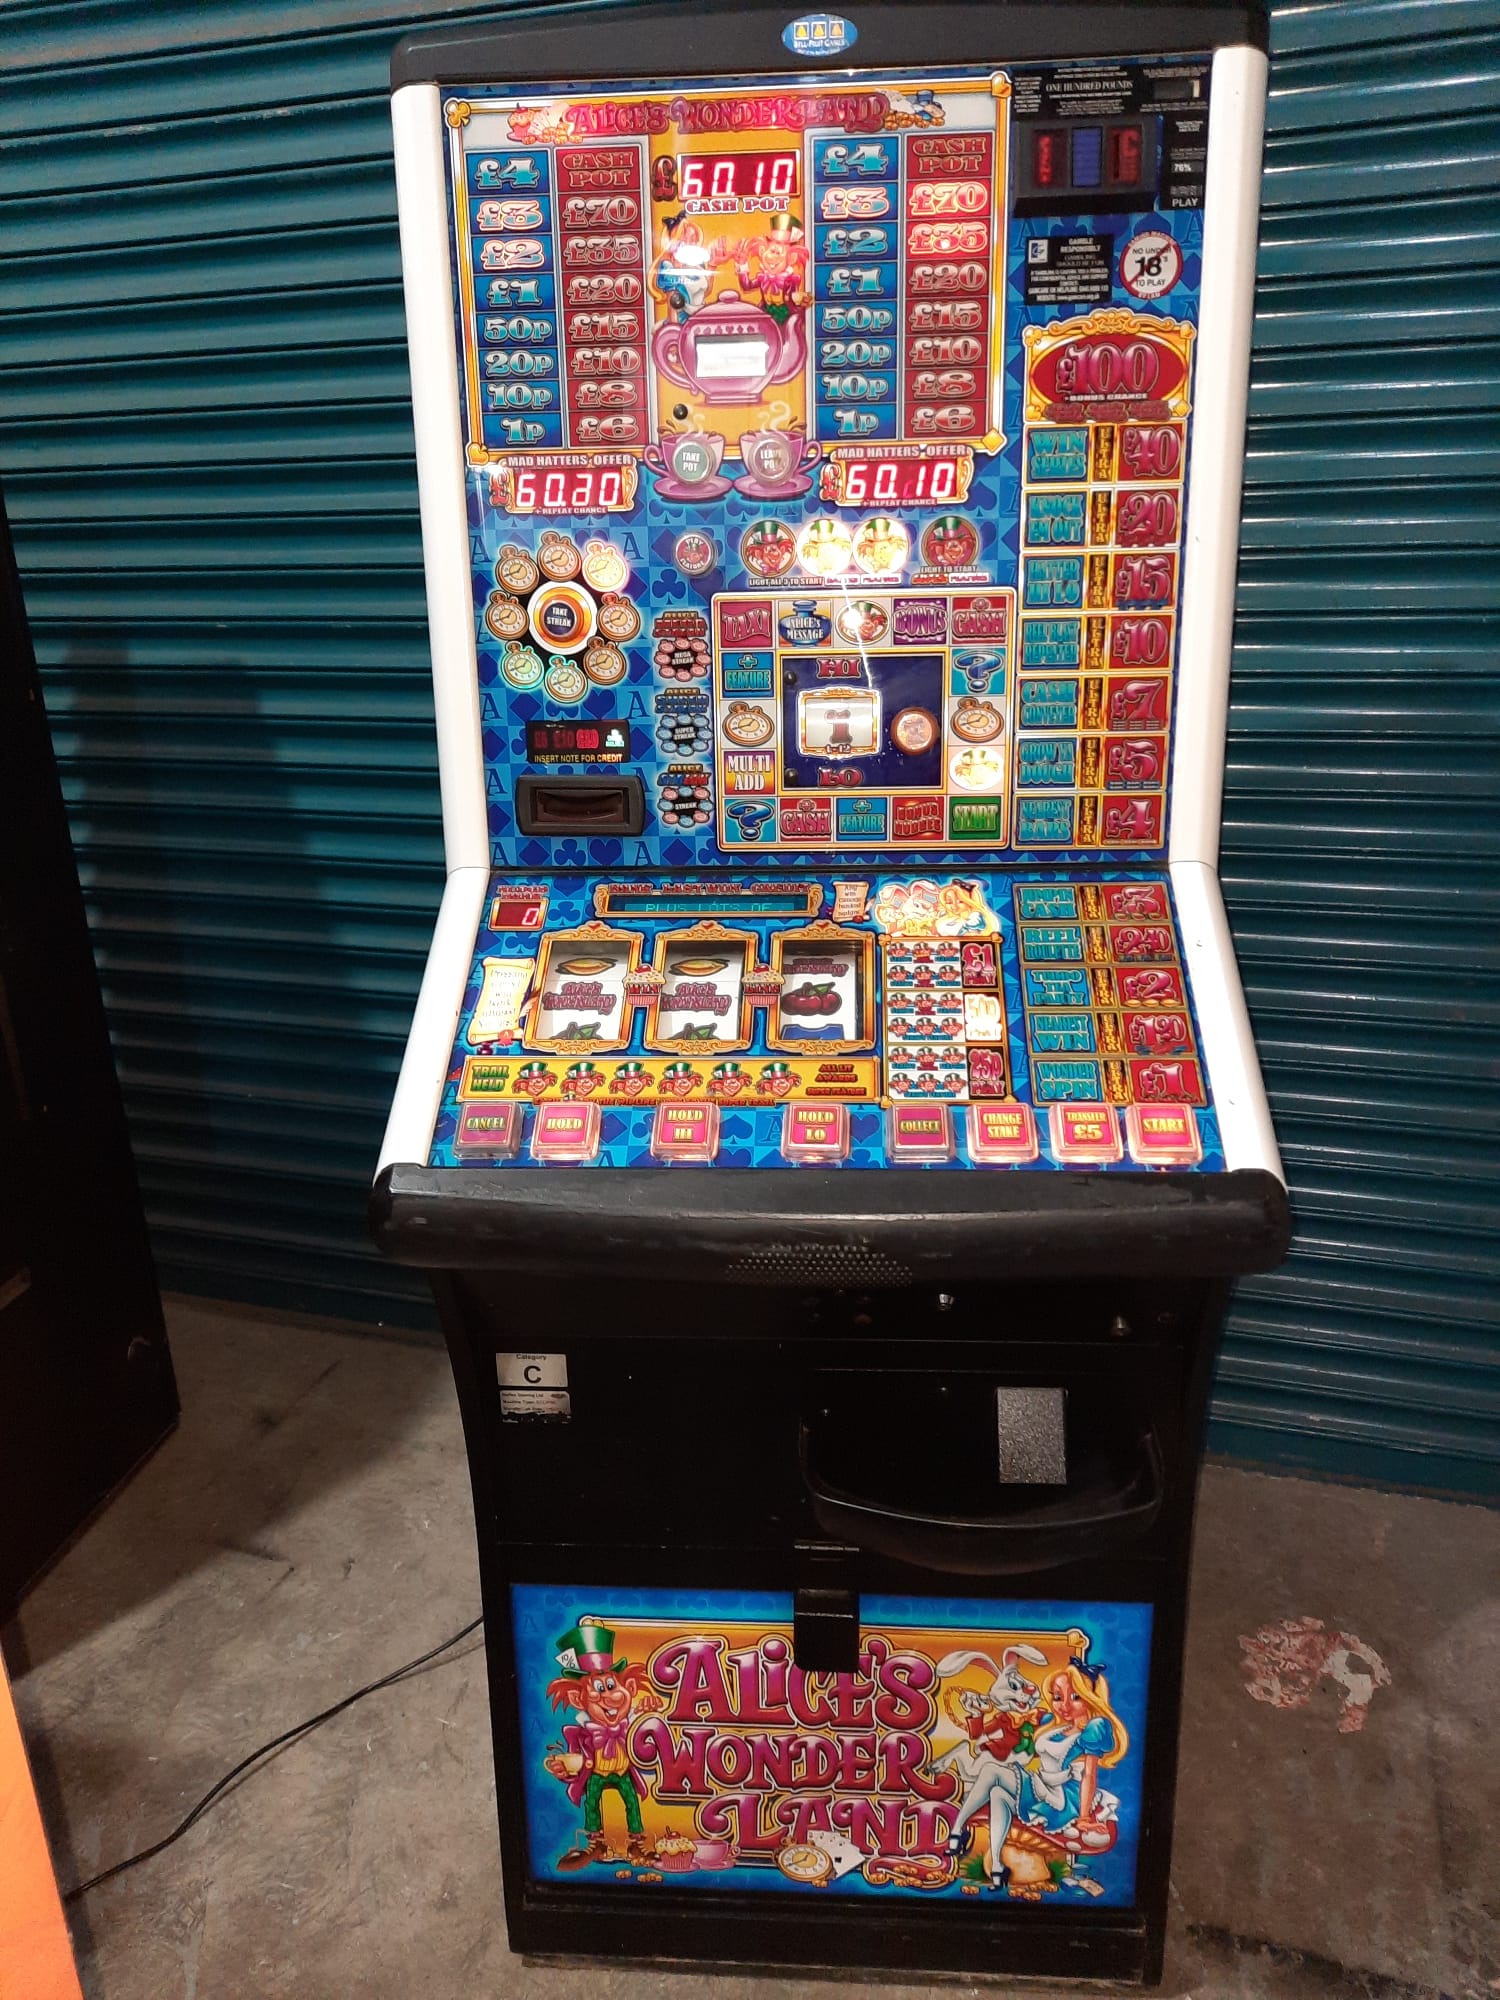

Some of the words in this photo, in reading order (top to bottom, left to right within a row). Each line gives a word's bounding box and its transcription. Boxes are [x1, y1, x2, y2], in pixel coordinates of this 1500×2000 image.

[1046, 83, 1061, 92] ONE
[1063, 81, 1101, 92] HUNDRED
[1102, 80, 1133, 90] POUNDS
[913, 137, 986, 156] CASH
[562, 152, 633, 170] CASH
[822, 144, 889, 176] £4
[919, 155, 982, 174] POT
[475, 157, 541, 189] £4
[570, 170, 630, 188] POT
[686, 198, 738, 215] CASH
[743, 196, 791, 212] POT
[821, 187, 889, 218] £3
[909, 182, 988, 216] £70
[1172, 198, 1199, 207] PLAY
[477, 200, 543, 231] £3
[562, 197, 638, 229] £70
[563, 236, 640, 266] £35
[822, 227, 887, 256] £2
[909, 222, 987, 255] £35
[1132, 247, 1143, 255] NO
[481, 239, 544, 270] £2
[567, 274, 641, 305] £20
[827, 267, 883, 296] £1
[909, 263, 987, 292] £20
[1136, 279, 1146, 287] TO
[1147, 279, 1166, 287] PLAY
[488, 279, 541, 307] £1
[485, 315, 552, 342] 50p
[568, 313, 639, 341] £15
[822, 305, 892, 331] 50p
[909, 301, 983, 331] £15
[571, 347, 640, 376] £10
[822, 340, 890, 365] 20p
[909, 336, 981, 365] £10
[485, 350, 553, 377] 20p
[1056, 341, 1159, 394] £100
[488, 383, 552, 409] 10p
[575, 380, 637, 409] £8
[822, 374, 889, 400] 10p
[912, 370, 976, 398] £8
[501, 417, 545, 444] 1p
[575, 415, 638, 442] £6
[834, 408, 879, 436] 1p
[911, 405, 975, 433] £6
[838, 448, 863, 458] MAD
[926, 445, 966, 456] OFFER
[1030, 431, 1088, 455] WIN
[1123, 427, 1181, 477] £40
[508, 456, 533, 466] MAD
[593, 454, 631, 465] OFFER
[682, 452, 700, 463] TAKE
[683, 462, 698, 472] POT
[1118, 491, 1177, 536] £20
[954, 565, 977, 573] START
[1115, 555, 1171, 600] £15
[749, 579, 768, 587] LIGHT
[789, 578, 799, 586] TO
[800, 577, 823, 585] START
[547, 616, 571, 627] STREAK
[552, 607, 569, 617] TAKE
[721, 606, 772, 641] TAXI
[788, 616, 821, 629] ALICE'S
[893, 605, 949, 637] BONUS
[952, 609, 1006, 639] CASH
[786, 627, 824, 641] MESSAGE
[1113, 619, 1168, 664] £10
[816, 657, 861, 678] HI
[724, 670, 771, 691] FEATURE
[1021, 681, 1077, 704] CASH
[1111, 679, 1164, 720] £7
[535, 755, 559, 763] INSERT
[597, 754, 623, 762] CREDIT
[727, 756, 770, 774] MULTI
[1109, 739, 1158, 781] £5
[734, 774, 765, 792] ADD
[817, 767, 862, 788] LO
[675, 802, 697, 810] STREAK
[953, 804, 998, 832] START
[780, 810, 832, 837] CASH
[839, 814, 884, 833] FEATURE
[1106, 800, 1155, 839] £4
[1020, 902, 1077, 919] CASH
[1111, 886, 1160, 915] £3
[522, 908, 540, 926] 0
[1023, 927, 1081, 944] REEL
[961, 943, 994, 971] £1
[1124, 970, 1176, 999] £2
[1036, 1031, 1090, 1050] WIN
[472, 1065, 509, 1079] TRAIL
[969, 1049, 1002, 1080] 25p
[1037, 1062, 1096, 1081] WONDER
[471, 1078, 504, 1092] HELD
[1040, 1080, 1097, 1100] SPIN
[1139, 1063, 1184, 1099] £1
[466, 1117, 506, 1130] CANCEL
[547, 1117, 583, 1130] HOLD
[667, 1109, 703, 1122] HOLD
[797, 1111, 835, 1124] HOLD
[900, 1120, 940, 1132] COLLECT
[983, 1113, 1023, 1125] CHANGE
[1143, 1118, 1185, 1133] START
[806, 1128, 826, 1142] LO
[987, 1126, 1020, 1139] STAKE
[1073, 1124, 1102, 1141] £5
[524, 1365, 541, 1384] C
[632, 1722, 957, 1799] WONDER
[699, 1794, 960, 1881] LAND
